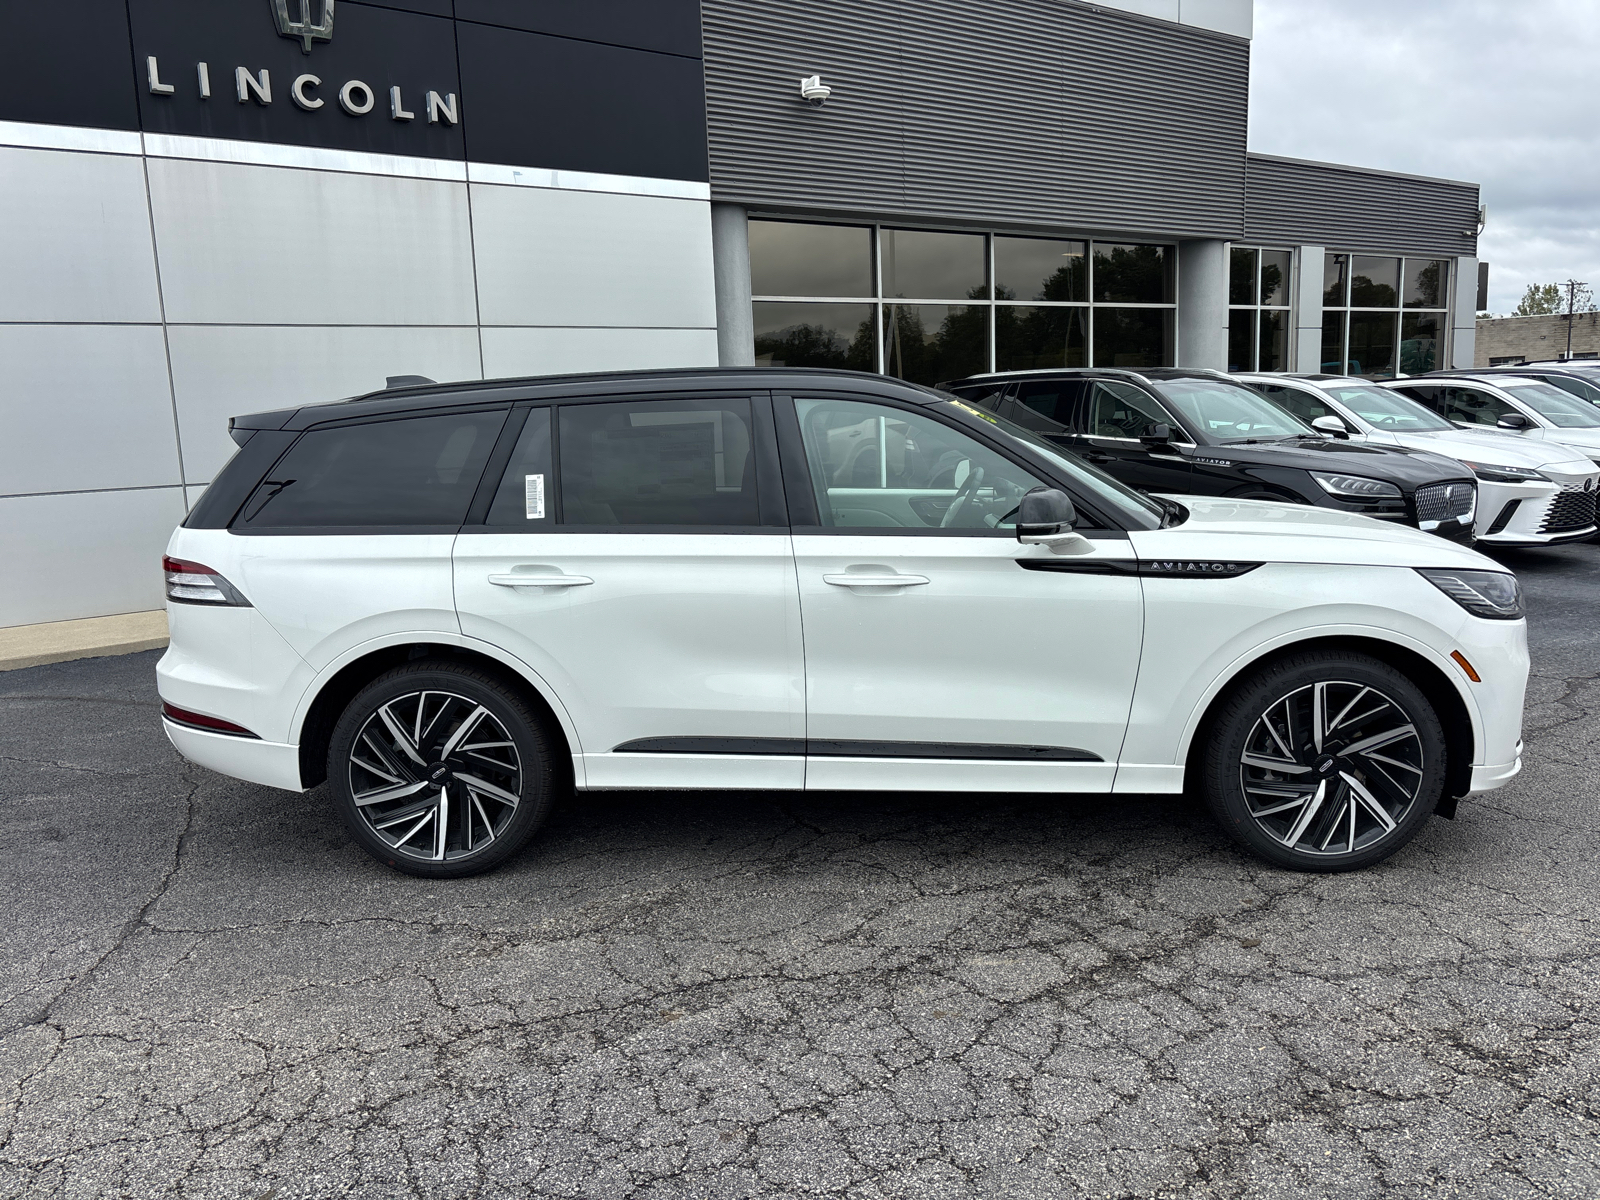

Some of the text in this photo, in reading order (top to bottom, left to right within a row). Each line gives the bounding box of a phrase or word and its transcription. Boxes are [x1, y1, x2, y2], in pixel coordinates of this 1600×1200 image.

[147, 56, 458, 125] LINCOLN
[1196, 457, 1231, 465] AVIATOR
[1150, 561, 1238, 573] AVIATOR
